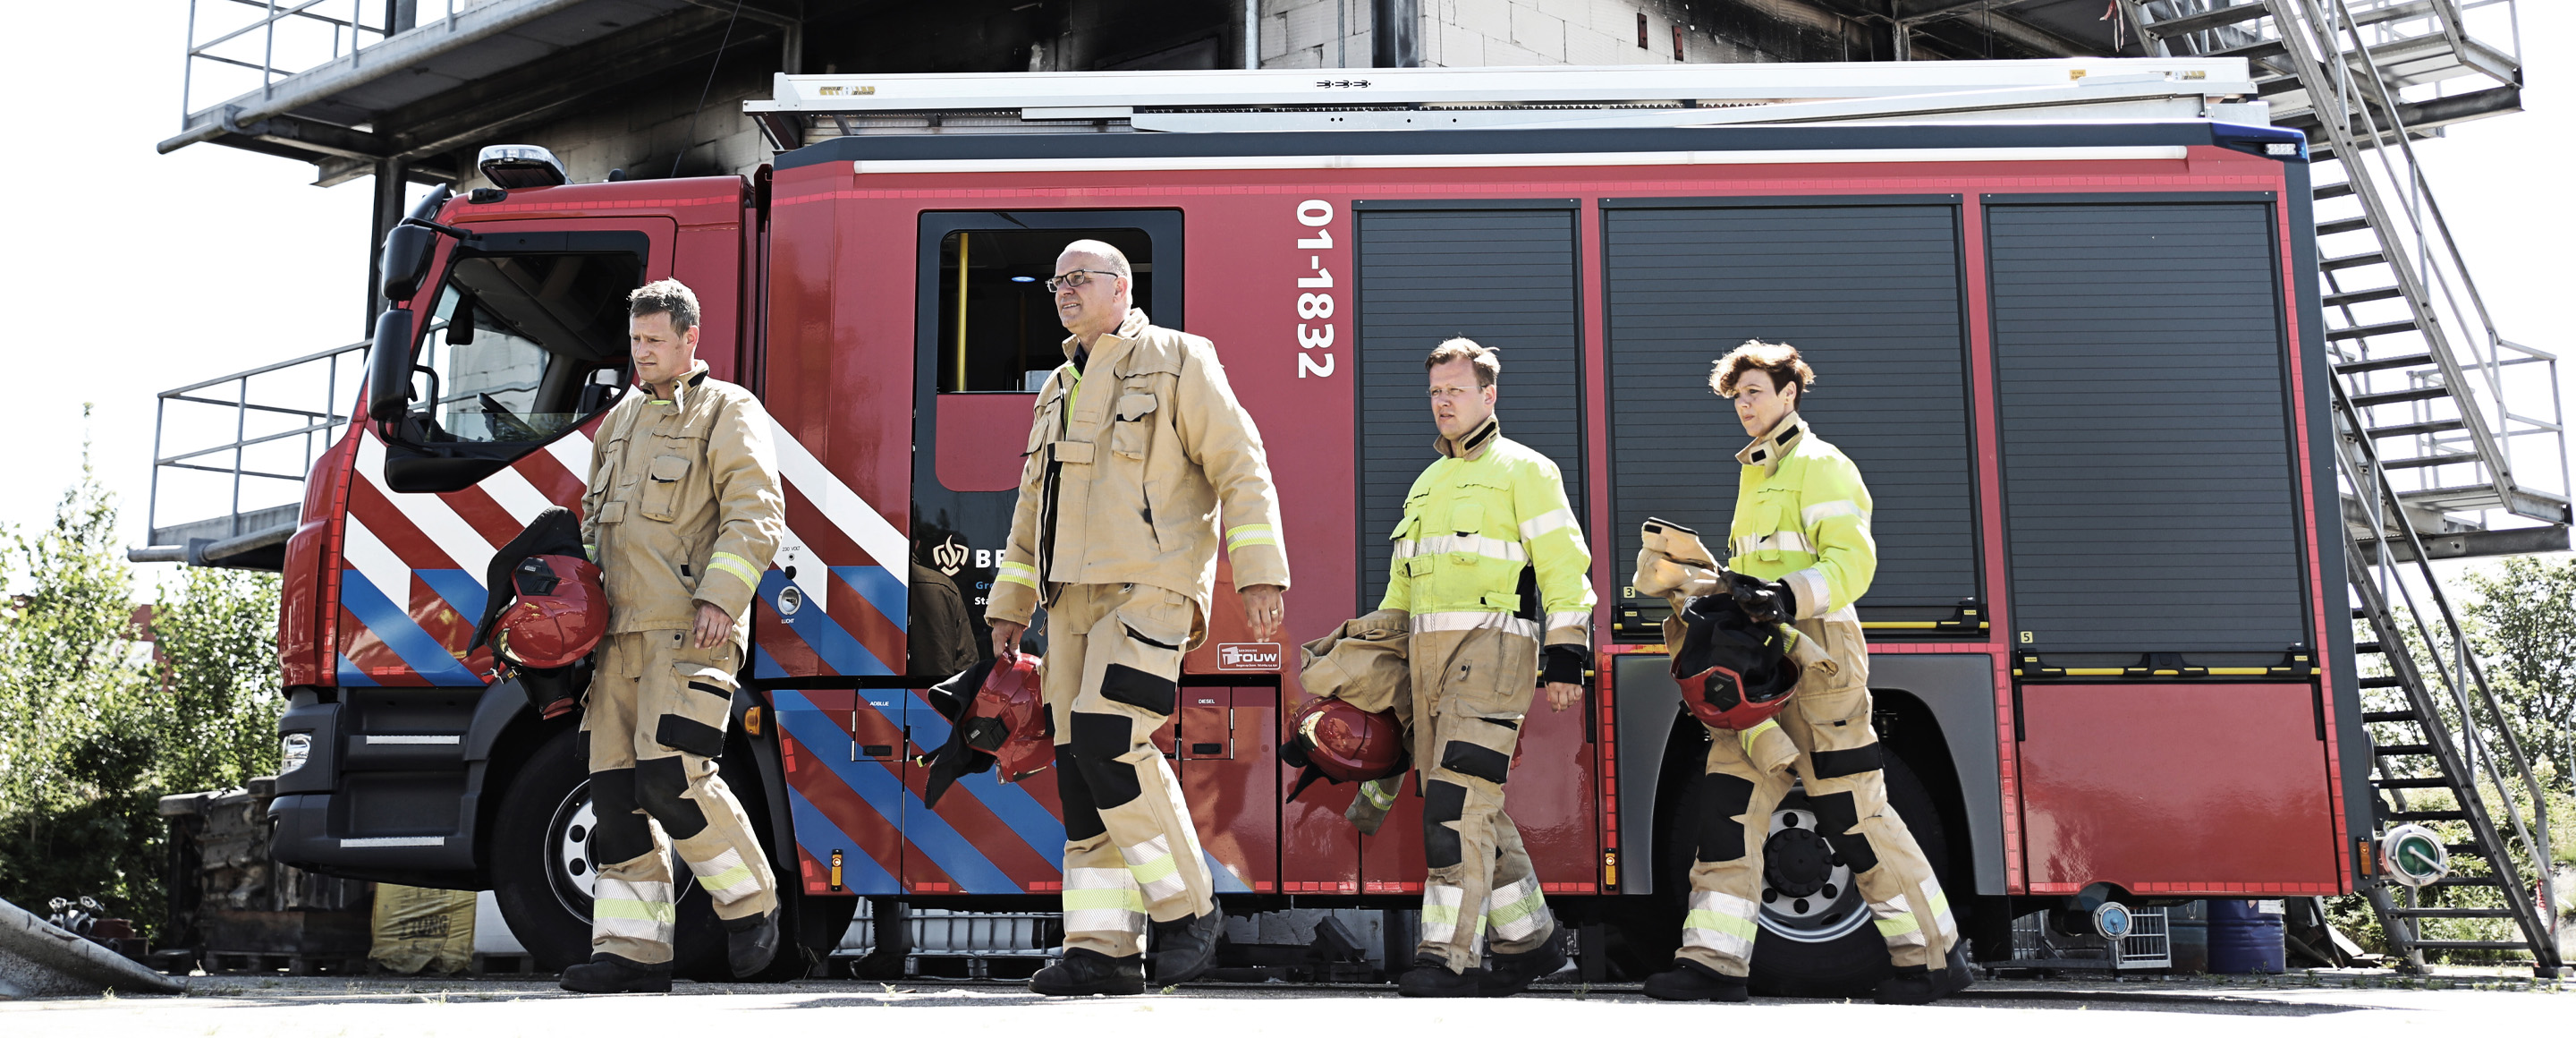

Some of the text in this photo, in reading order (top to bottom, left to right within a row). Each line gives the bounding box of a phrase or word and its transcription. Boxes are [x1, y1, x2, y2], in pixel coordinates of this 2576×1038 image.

[1297, 200, 1335, 378] 01-1832
[1626, 588, 1632, 597] 3
[2023, 633, 2030, 642] 5
[1234, 653, 1277, 662] TOUW
